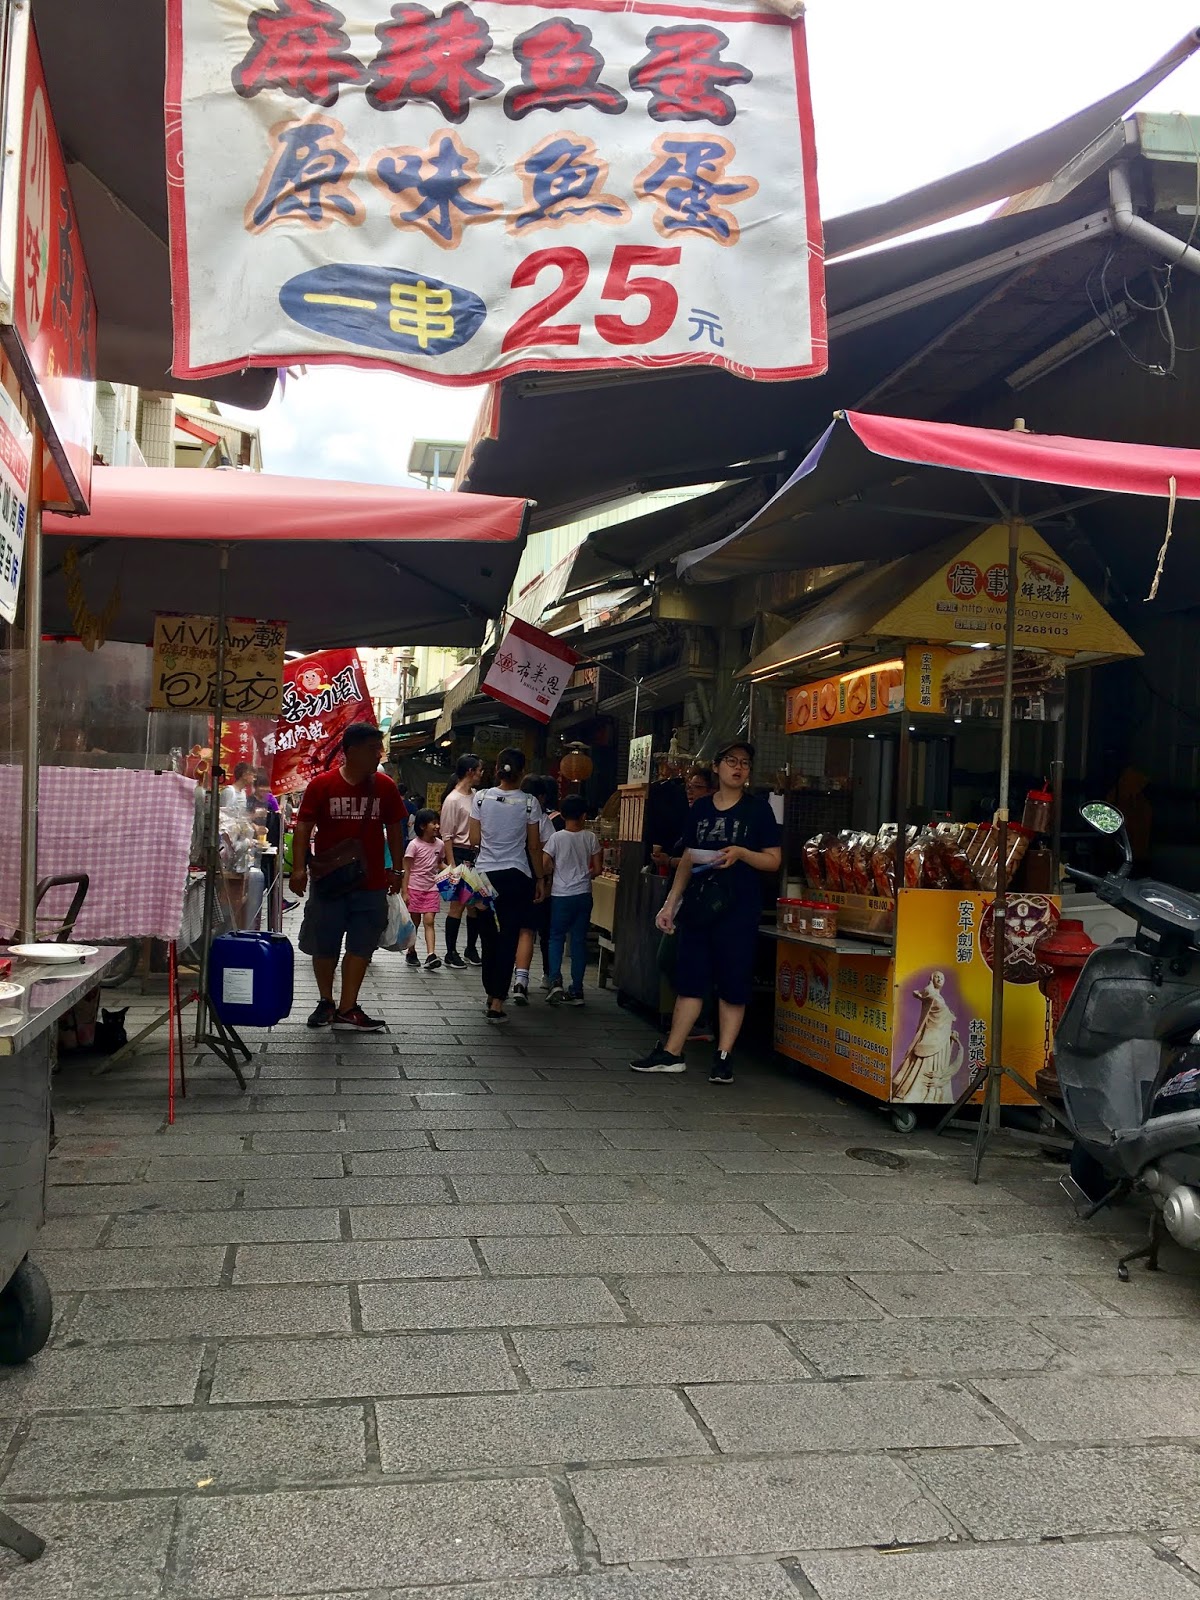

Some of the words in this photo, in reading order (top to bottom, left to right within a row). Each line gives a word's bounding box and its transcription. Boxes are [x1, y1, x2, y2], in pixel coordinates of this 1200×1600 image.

[231, 0, 754, 124] 麻辣魚蛋
[246, 117, 756, 249] 原味魚蛋
[303, 282, 455, 350] 一串
[501, 246, 683, 354] 25
[688, 309, 726, 348] 元
[1020, 581, 1071, 605] 鮮蝦餅
[517, 660, 560, 696] 布萊恩
[957, 901, 975, 963] 安平劍獅
